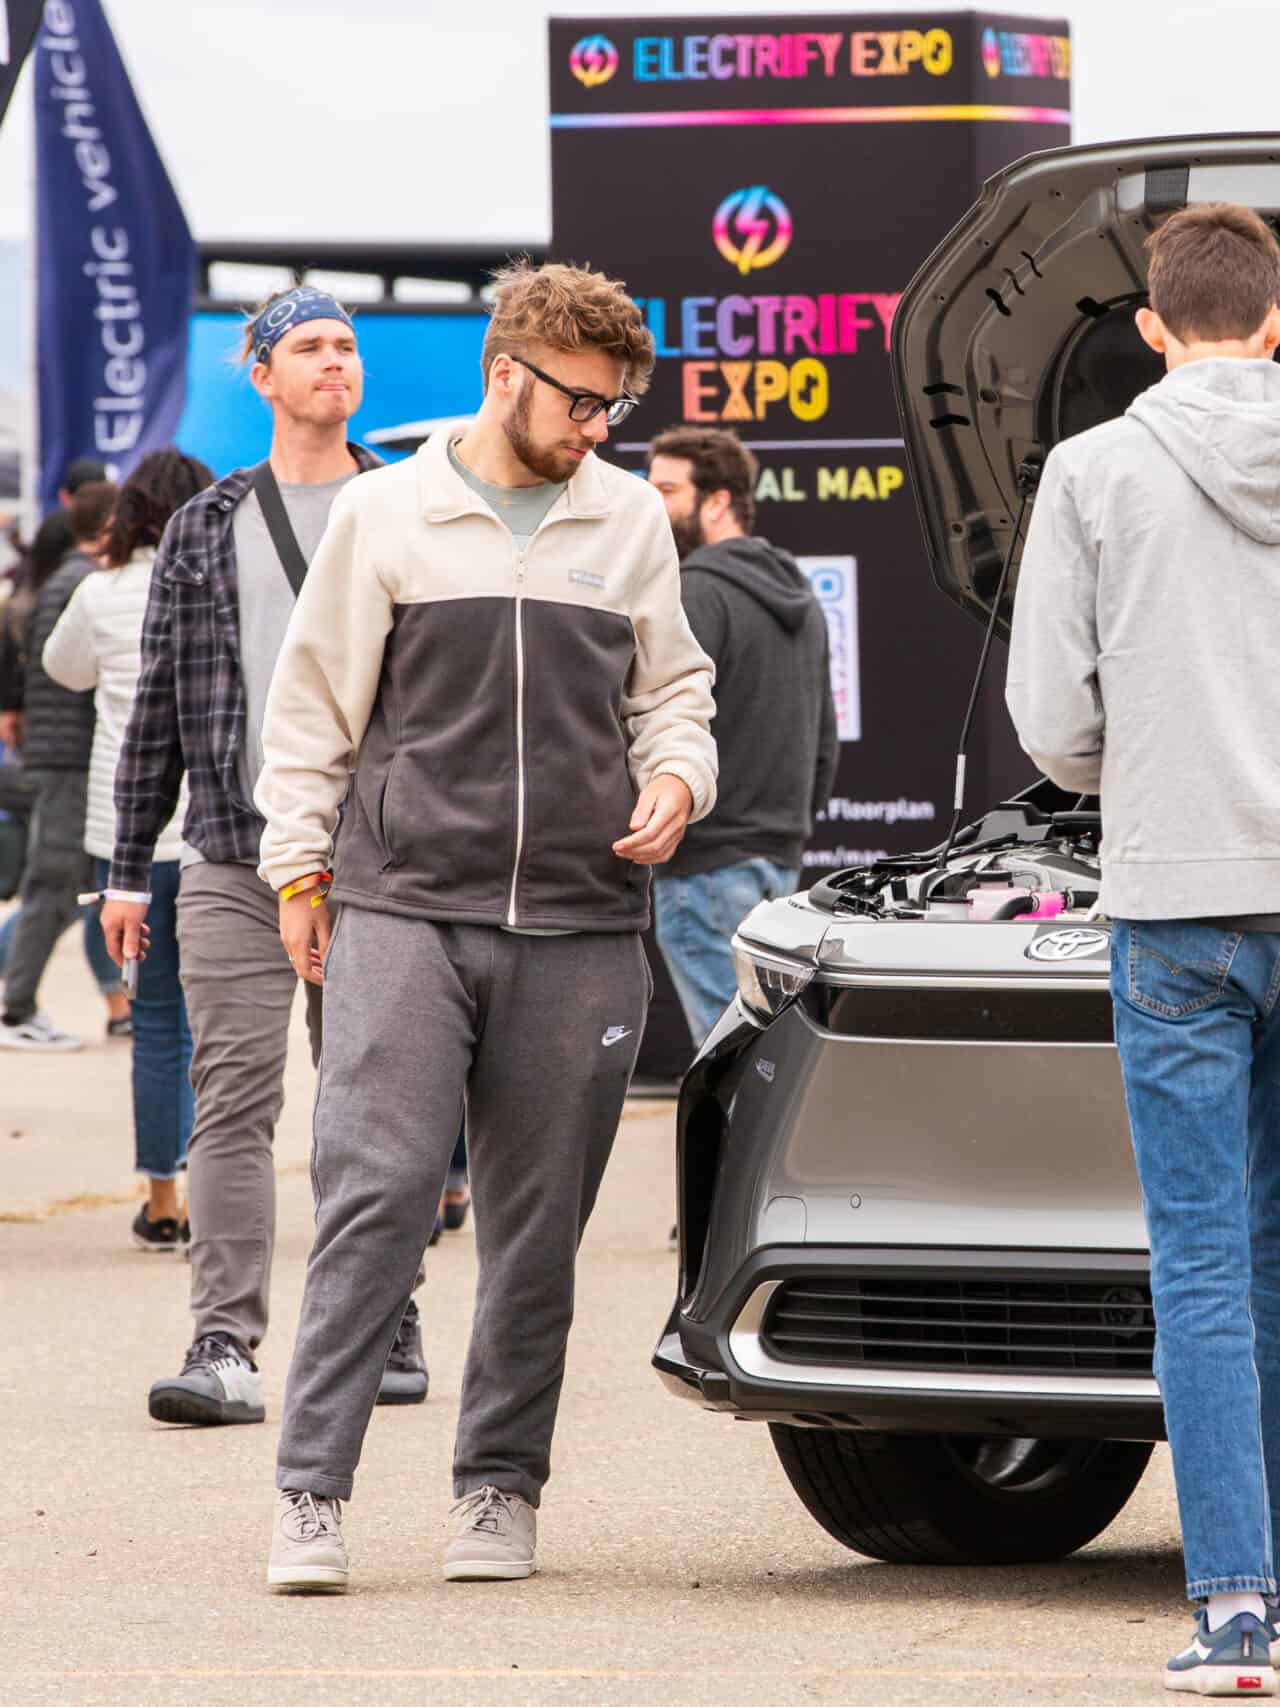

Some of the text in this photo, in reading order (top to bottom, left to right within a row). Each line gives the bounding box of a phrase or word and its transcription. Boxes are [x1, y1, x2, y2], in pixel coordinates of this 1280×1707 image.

[633, 32, 843, 82] ELECTRIFY
[850, 29, 953, 77] EXPO
[83, 225, 148, 453] Electric
[636, 292, 904, 358] LECTRIFY
[682, 358, 829, 422] EXPO
[755, 465, 904, 502] AL MAP
[827, 797, 936, 825] Floorplan
